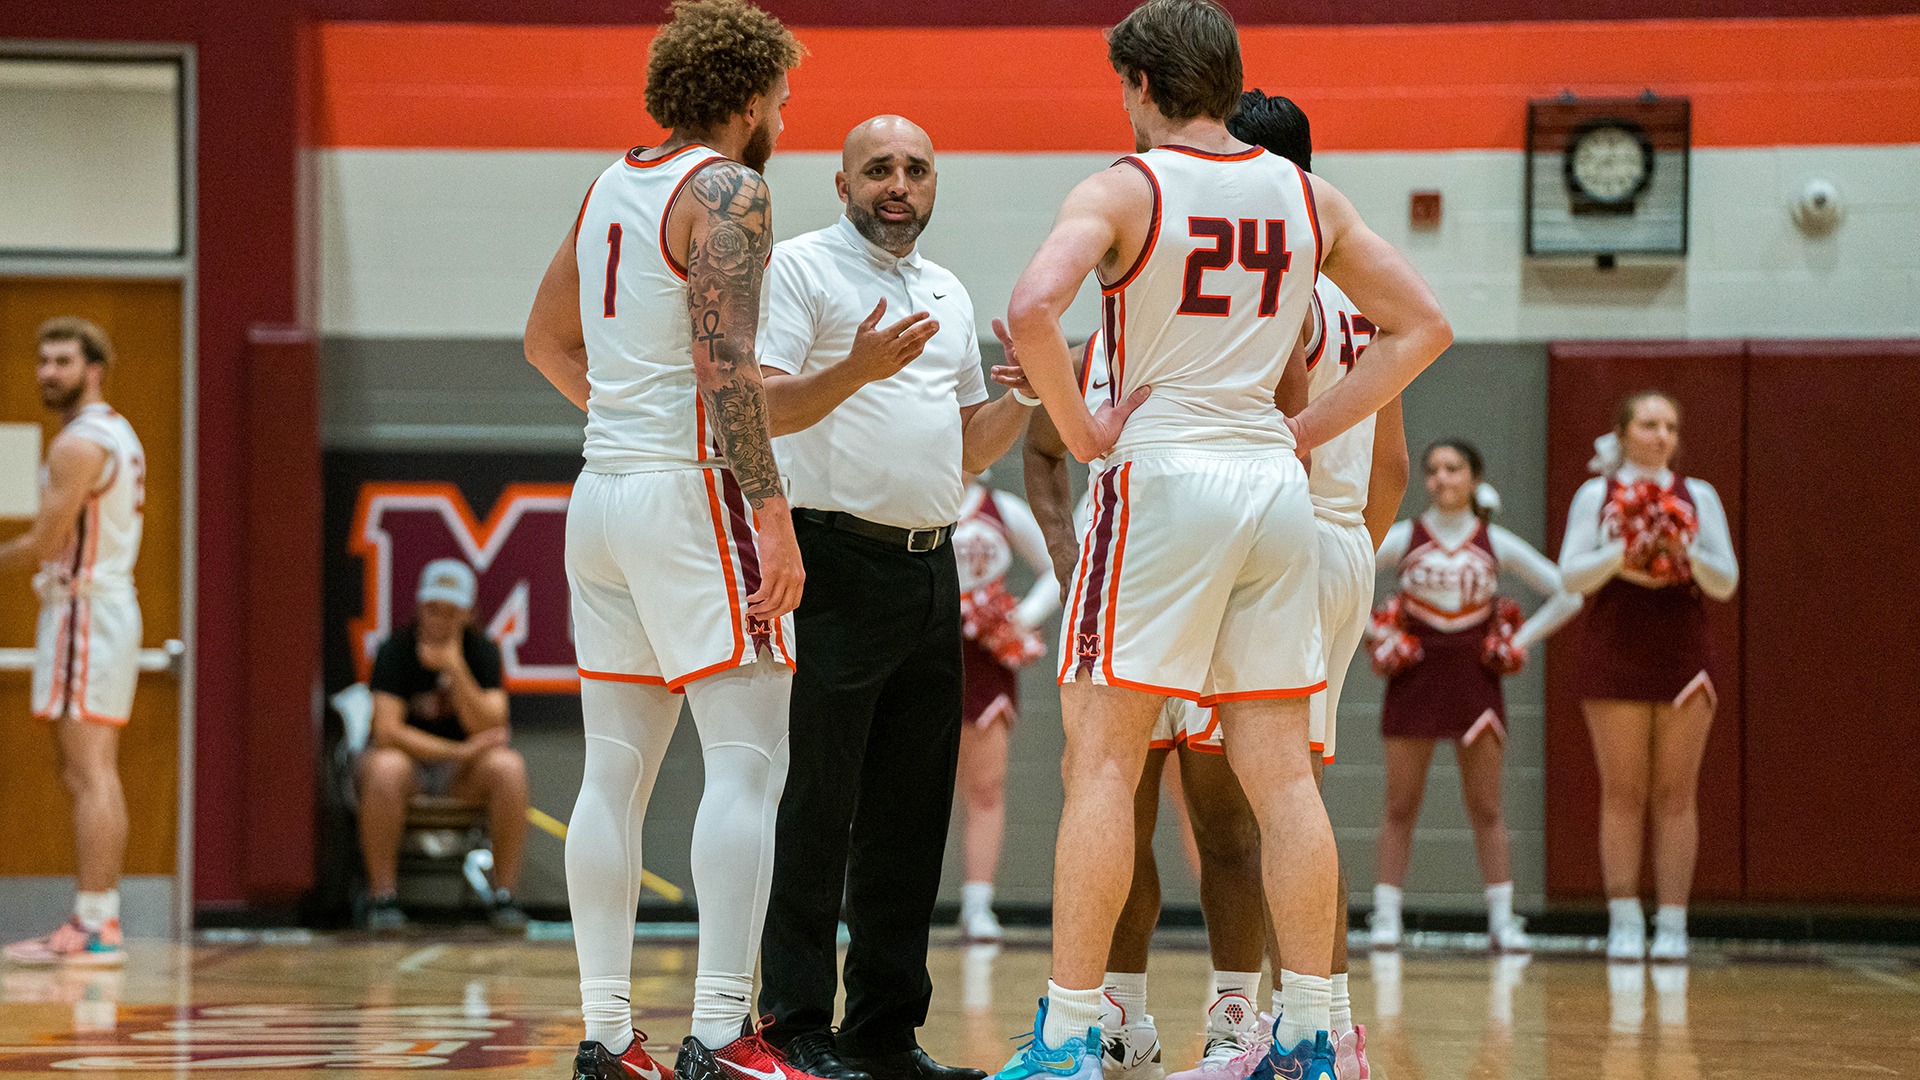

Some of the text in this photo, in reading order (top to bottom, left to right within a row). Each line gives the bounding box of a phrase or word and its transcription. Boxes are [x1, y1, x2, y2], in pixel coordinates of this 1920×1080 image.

[603, 223, 623, 318] 1
[1177, 216, 1292, 317] 24
[349, 481, 580, 694] M
[746, 613, 772, 635] M
[1076, 633, 1101, 656] M
